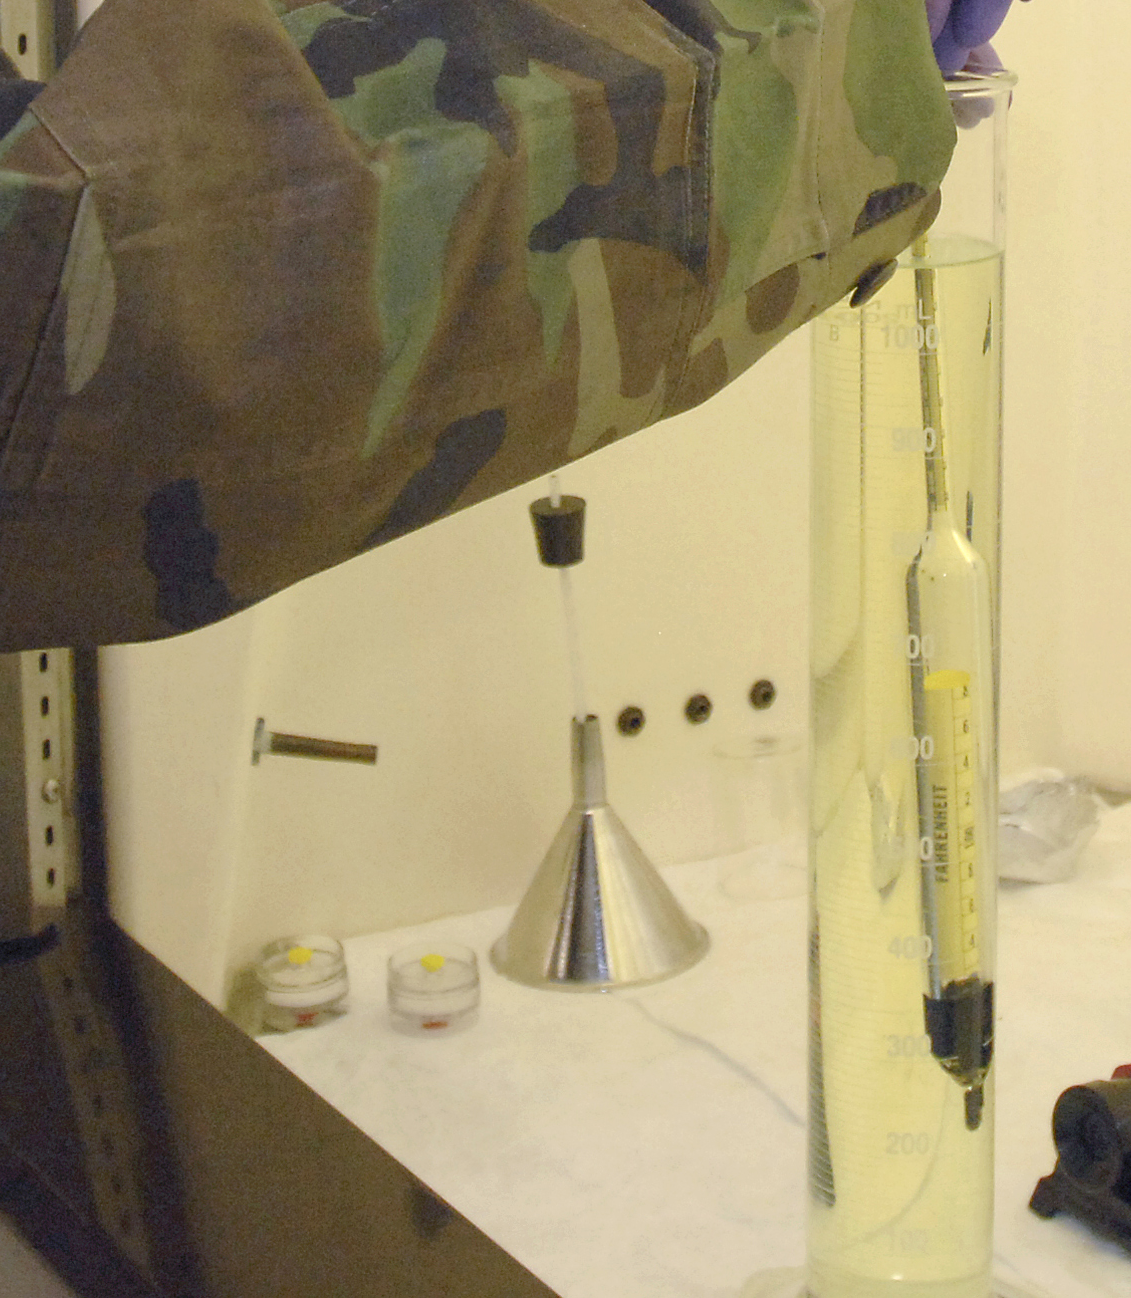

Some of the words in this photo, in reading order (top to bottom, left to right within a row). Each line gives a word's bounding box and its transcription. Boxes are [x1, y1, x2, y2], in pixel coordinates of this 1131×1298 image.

[881, 323, 939, 350] 1000
[932, 783, 950, 884] FAHRENHEIT
[887, 934, 932, 961] 400
[886, 1033, 932, 1058] 300
[885, 1131, 930, 1156] 200
